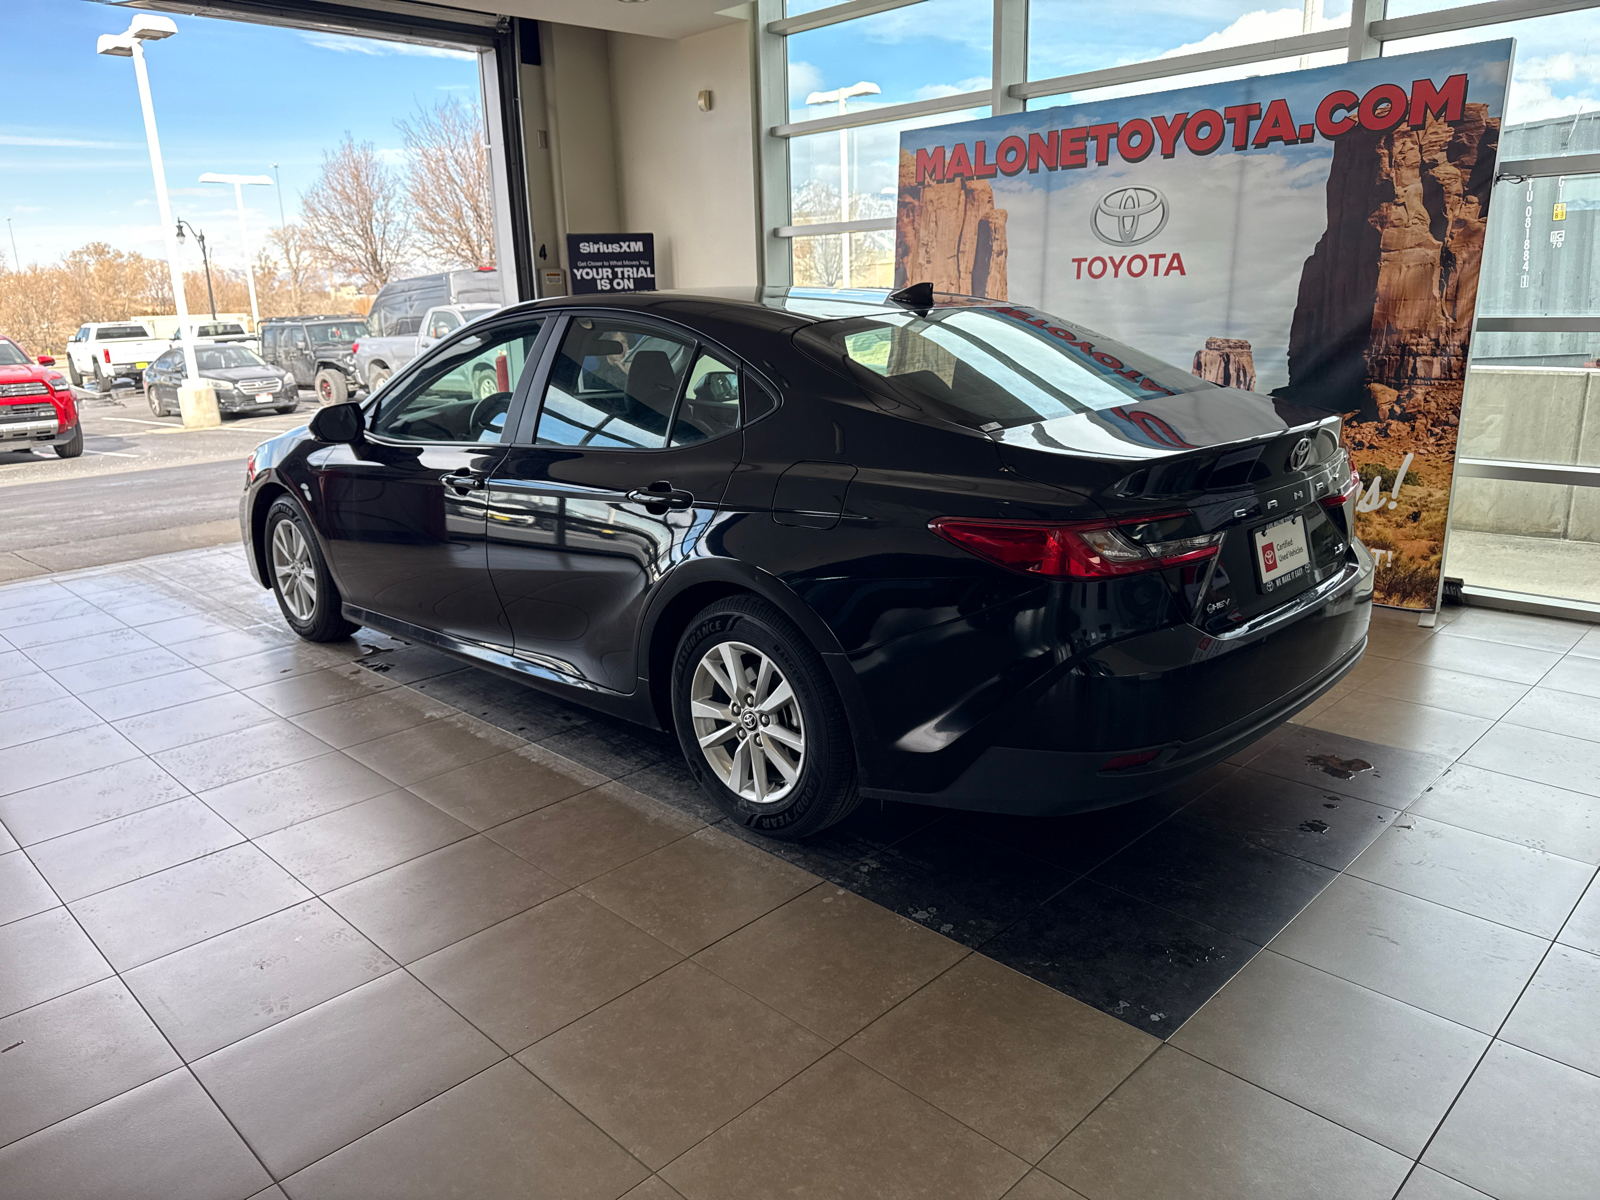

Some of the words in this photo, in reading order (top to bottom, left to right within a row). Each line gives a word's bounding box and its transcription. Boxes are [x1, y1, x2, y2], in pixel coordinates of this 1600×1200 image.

[915, 73, 1469, 184] MALONETOYOTA.COM
[539, 244, 547, 260] 4
[579, 241, 644, 253] SiriusXM
[1071, 253, 1186, 280] TOYOTA
[573, 267, 613, 280] YOUR
[614, 267, 655, 278] TRIAL
[597, 279, 611, 290] IS
[613, 278, 634, 290] ON
[1276, 538, 1293, 551] Certified
